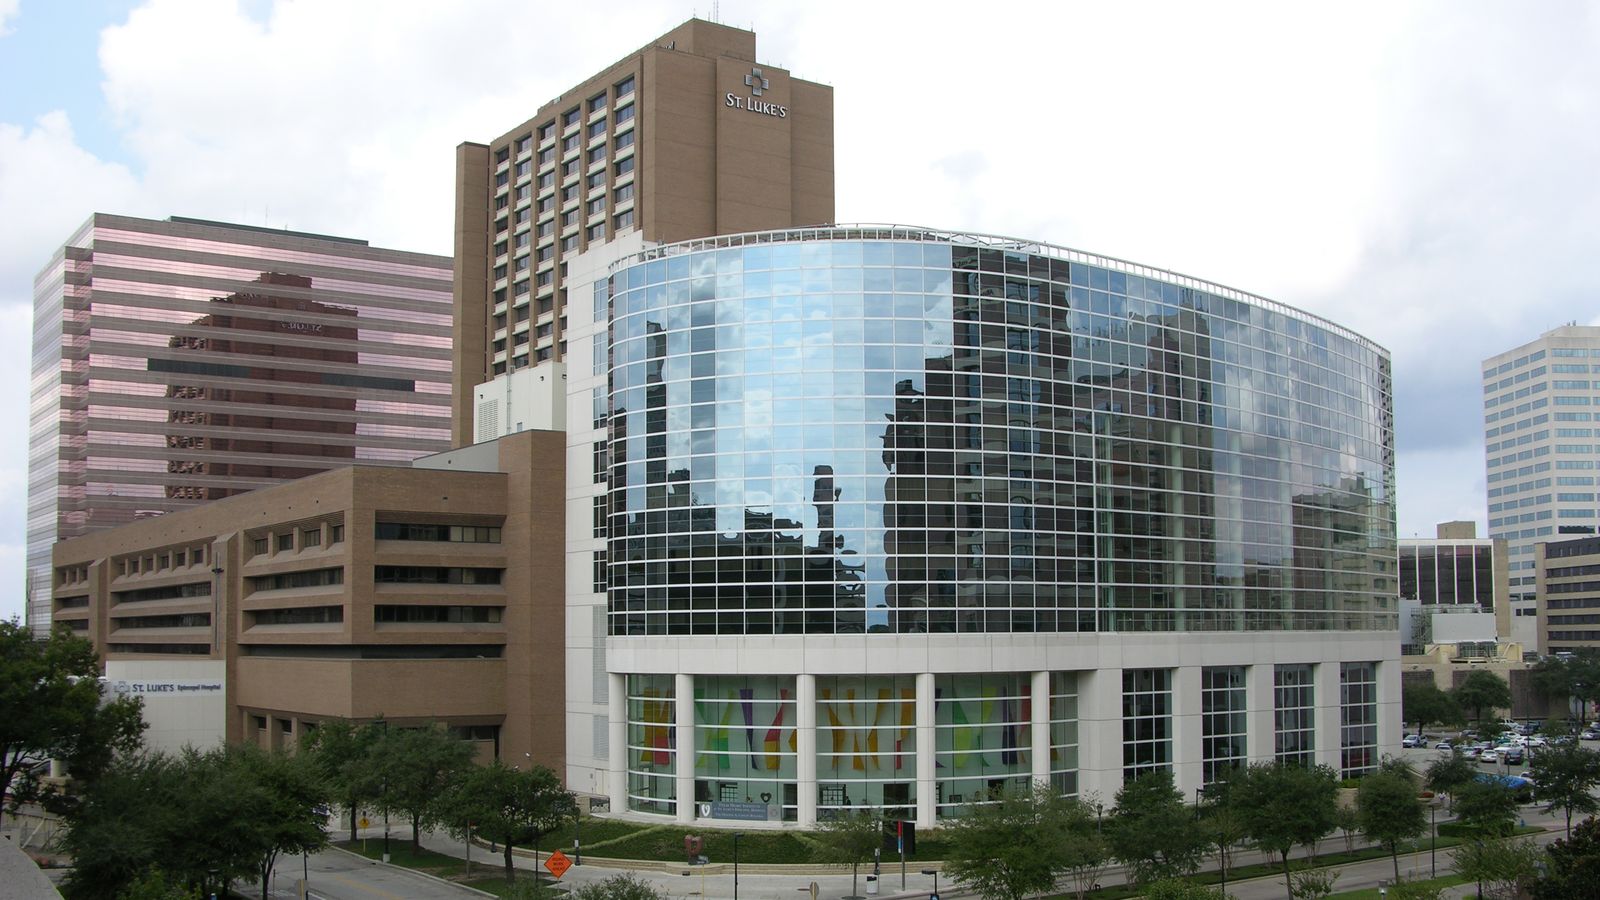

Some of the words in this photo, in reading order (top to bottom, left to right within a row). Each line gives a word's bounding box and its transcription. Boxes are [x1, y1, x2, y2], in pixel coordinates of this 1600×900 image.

[726, 93, 743, 108] ST.
[747, 97, 787, 118] LUKE'S
[147, 684, 174, 692] LUKE'S
